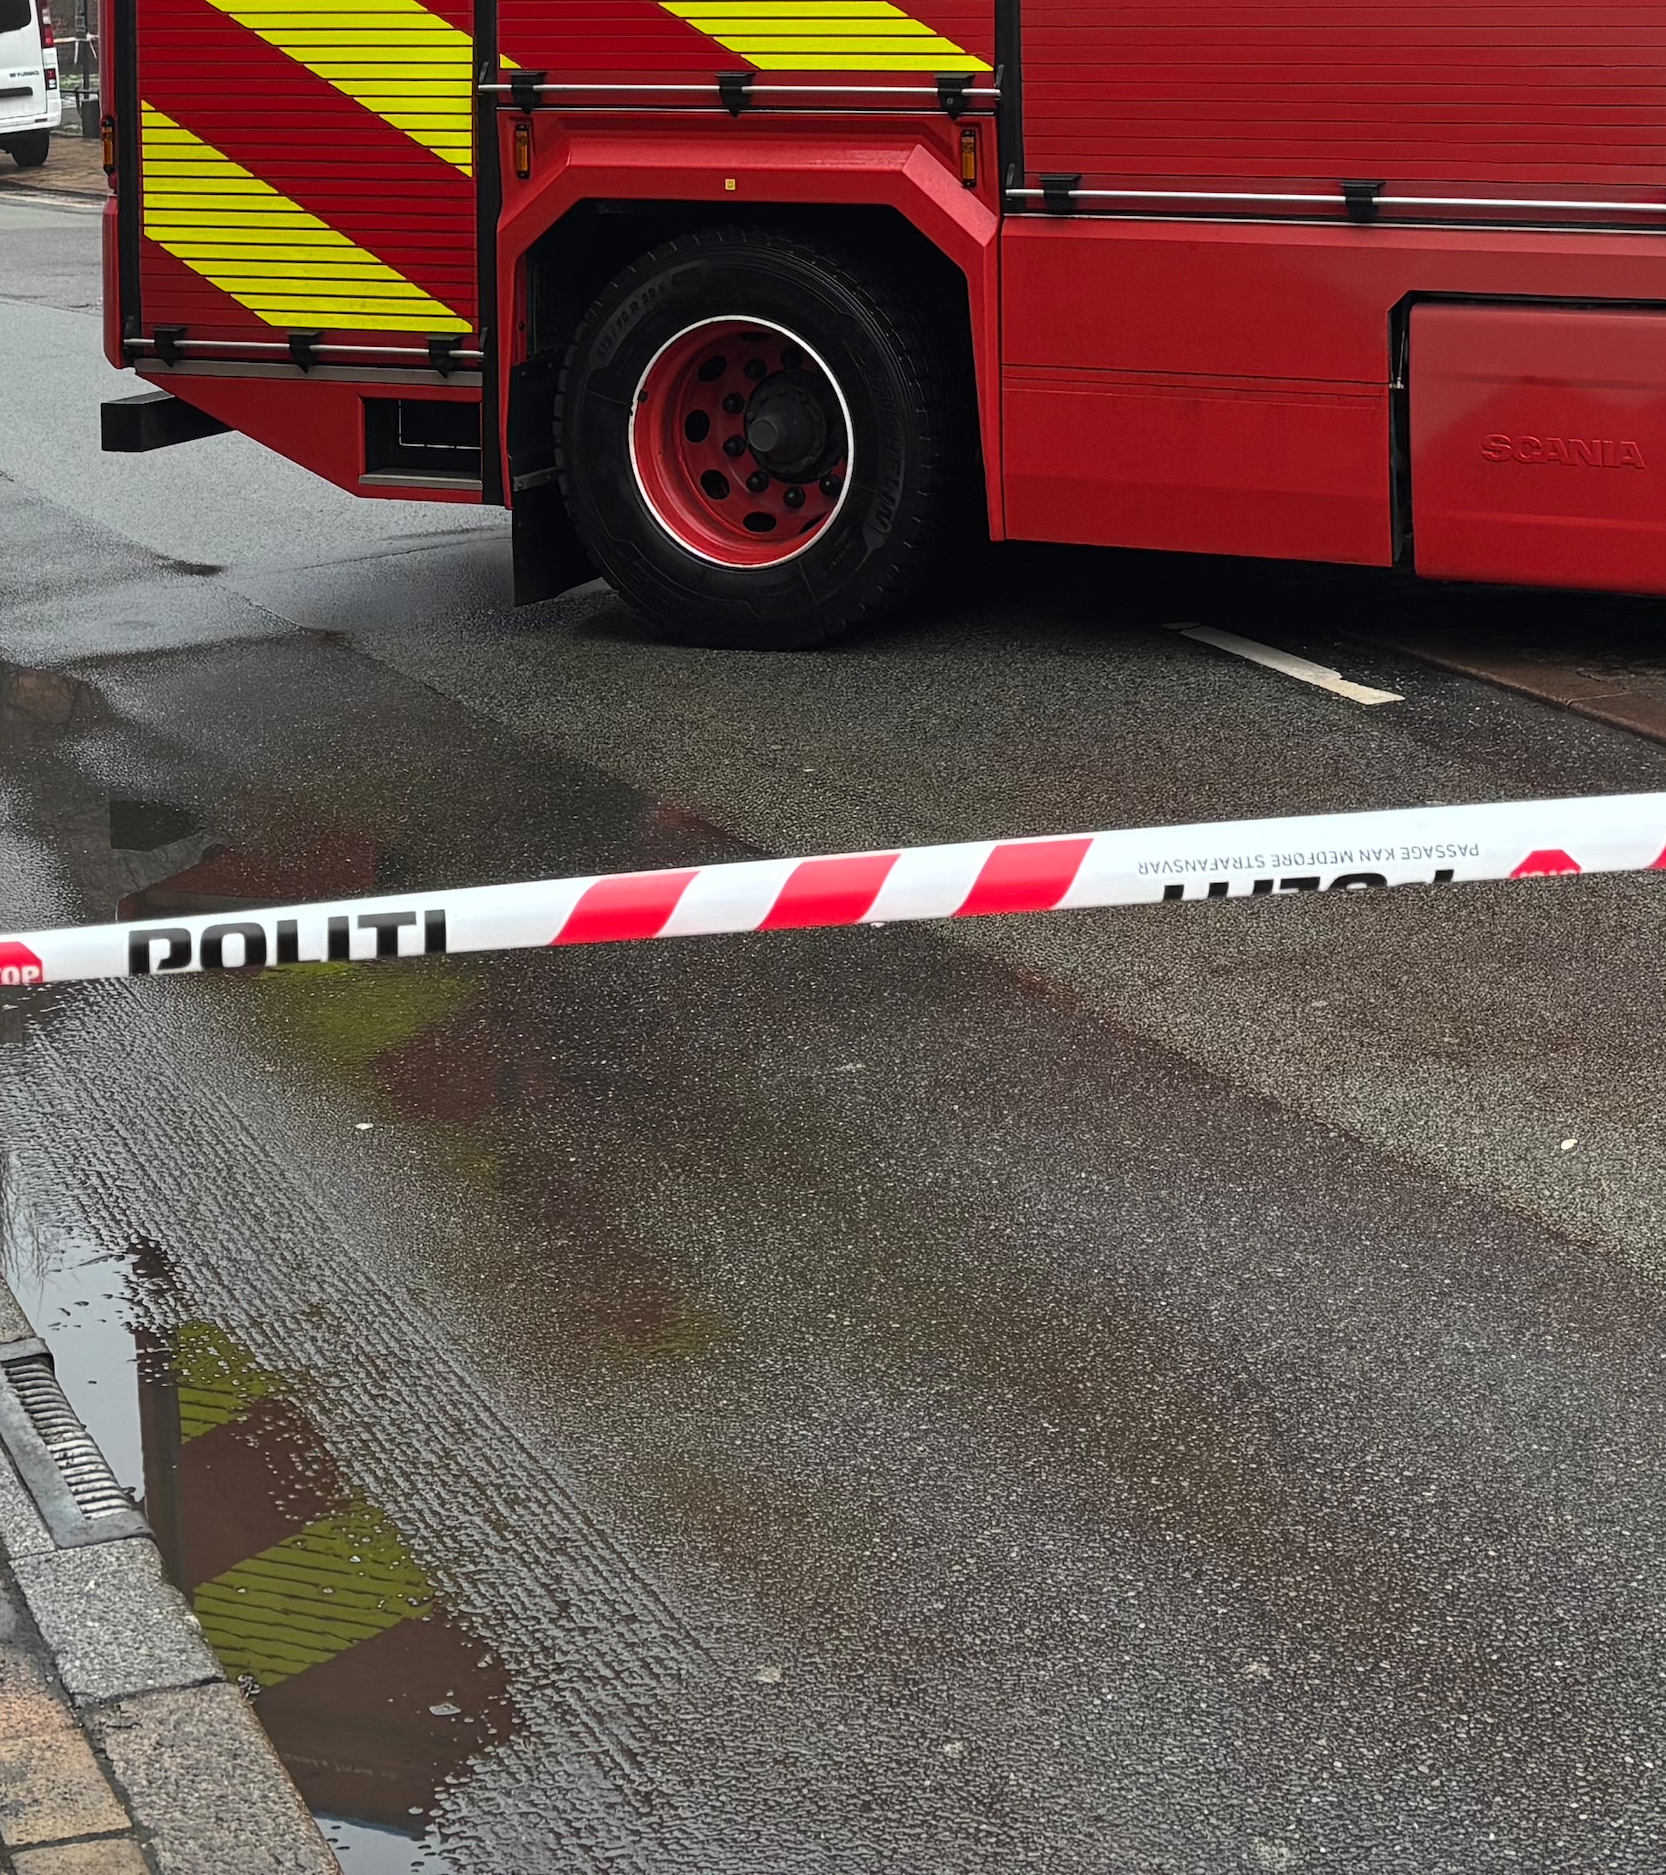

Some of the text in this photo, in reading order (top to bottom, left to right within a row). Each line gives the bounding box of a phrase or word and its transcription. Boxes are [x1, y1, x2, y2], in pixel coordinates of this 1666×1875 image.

[1480, 433, 1646, 470] SCANIA
[1358, 847, 1397, 863] KAN
[1400, 842, 1480, 860] PASSAGE
[1137, 852, 1267, 876] STRAFANSVAR
[127, 909, 447, 975] POLITI
